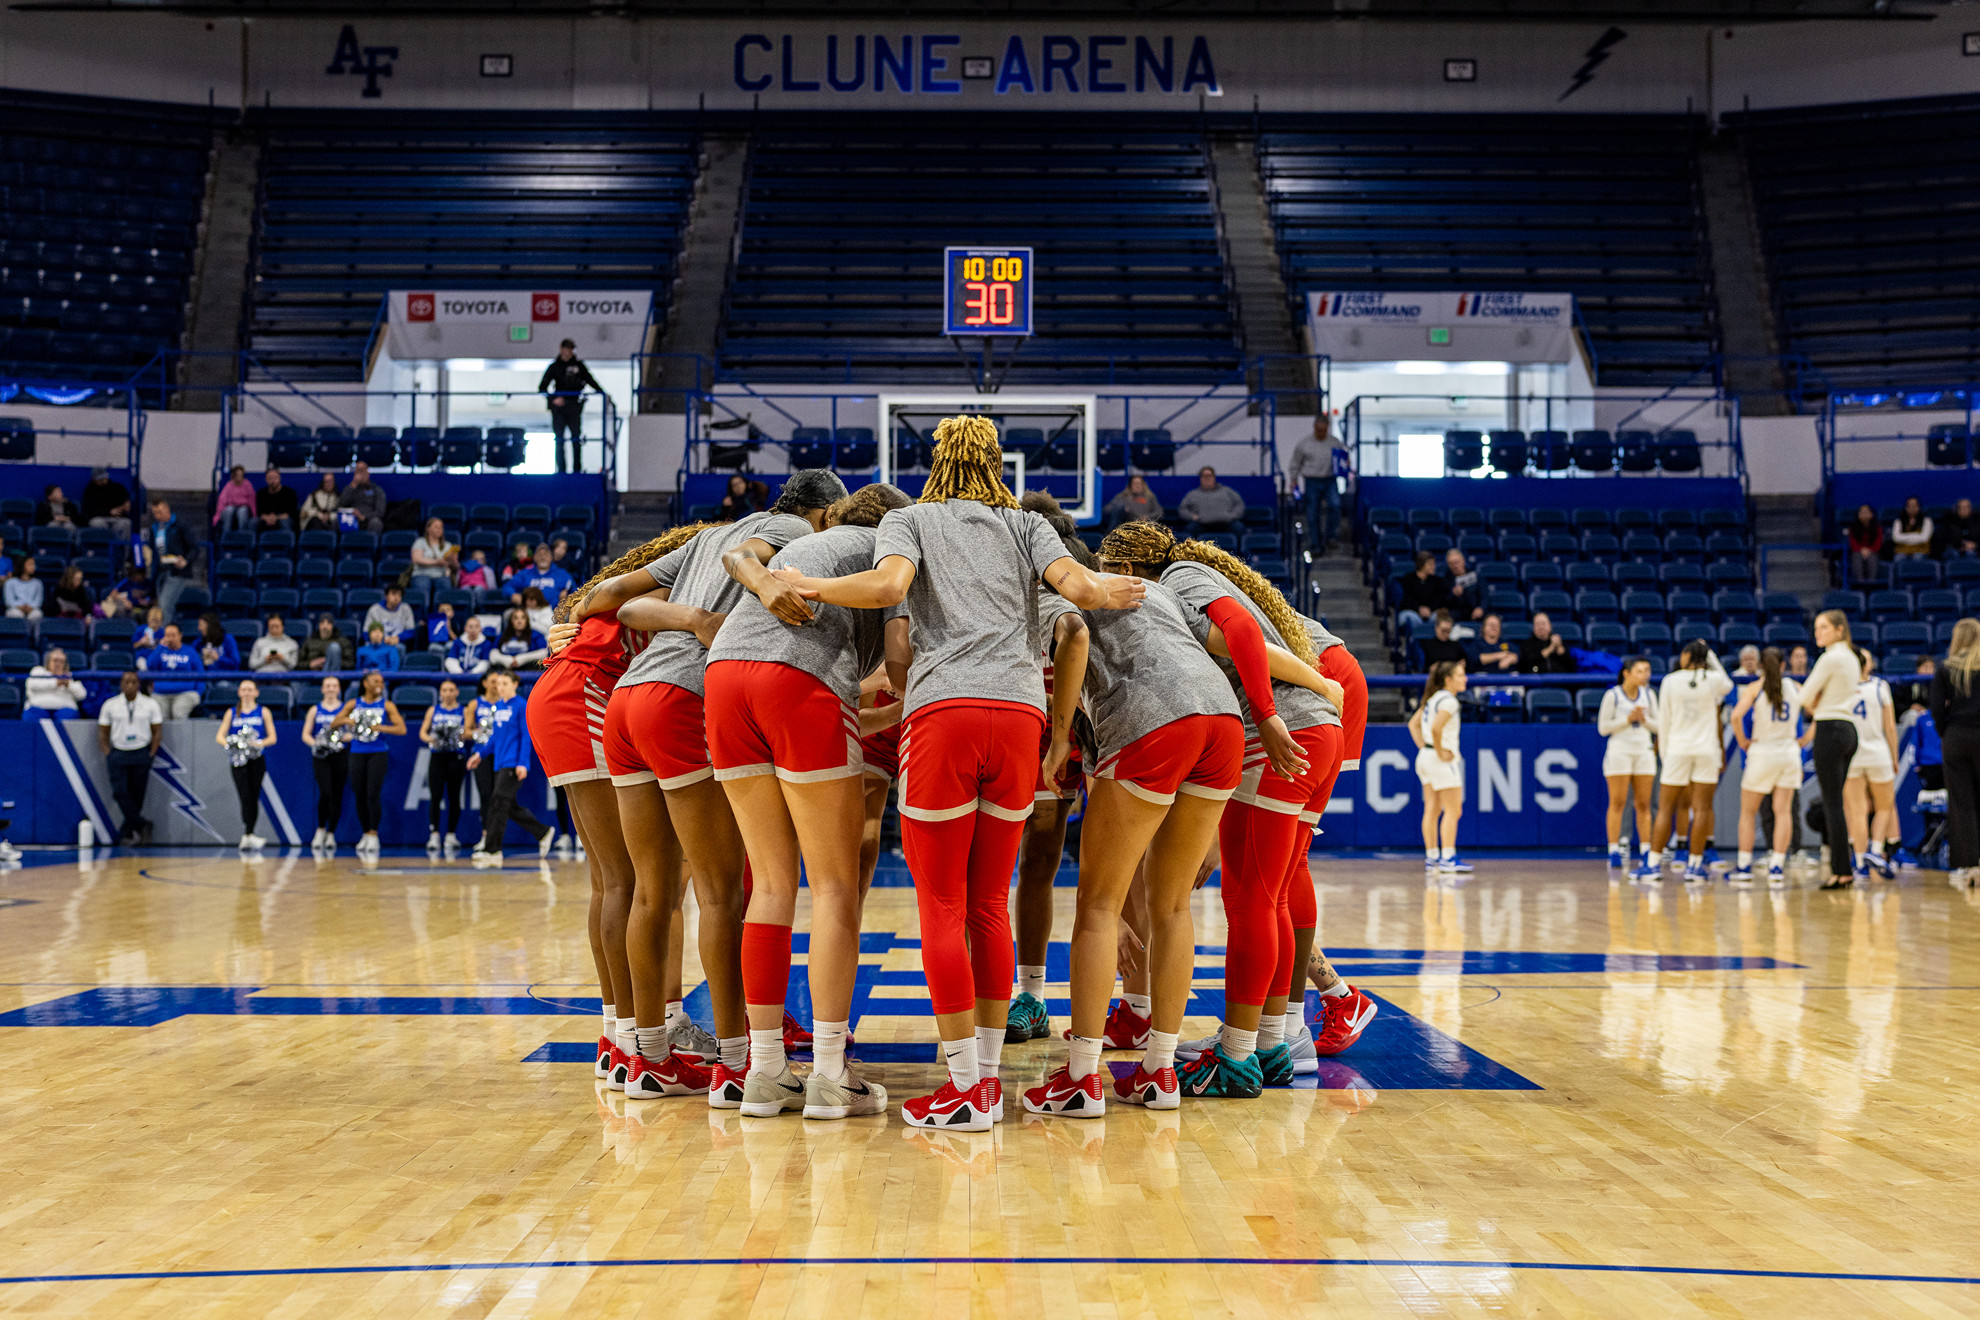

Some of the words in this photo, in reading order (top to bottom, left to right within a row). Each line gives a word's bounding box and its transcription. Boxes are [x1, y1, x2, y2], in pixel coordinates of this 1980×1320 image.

[734, 34, 962, 93] CLUNE
[994, 34, 1219, 94] ARENA
[963, 257, 1022, 281] 10:00
[965, 281, 1014, 325] 30
[1344, 291, 1385, 304] FIRST
[1482, 291, 1523, 304] FIRST
[441, 300, 509, 316] TOYOTA
[566, 300, 634, 316] TOYOTA
[1341, 305, 1421, 318] COMMAND
[1480, 305, 1560, 318] COMMAND
[1853, 699, 1867, 720] 4
